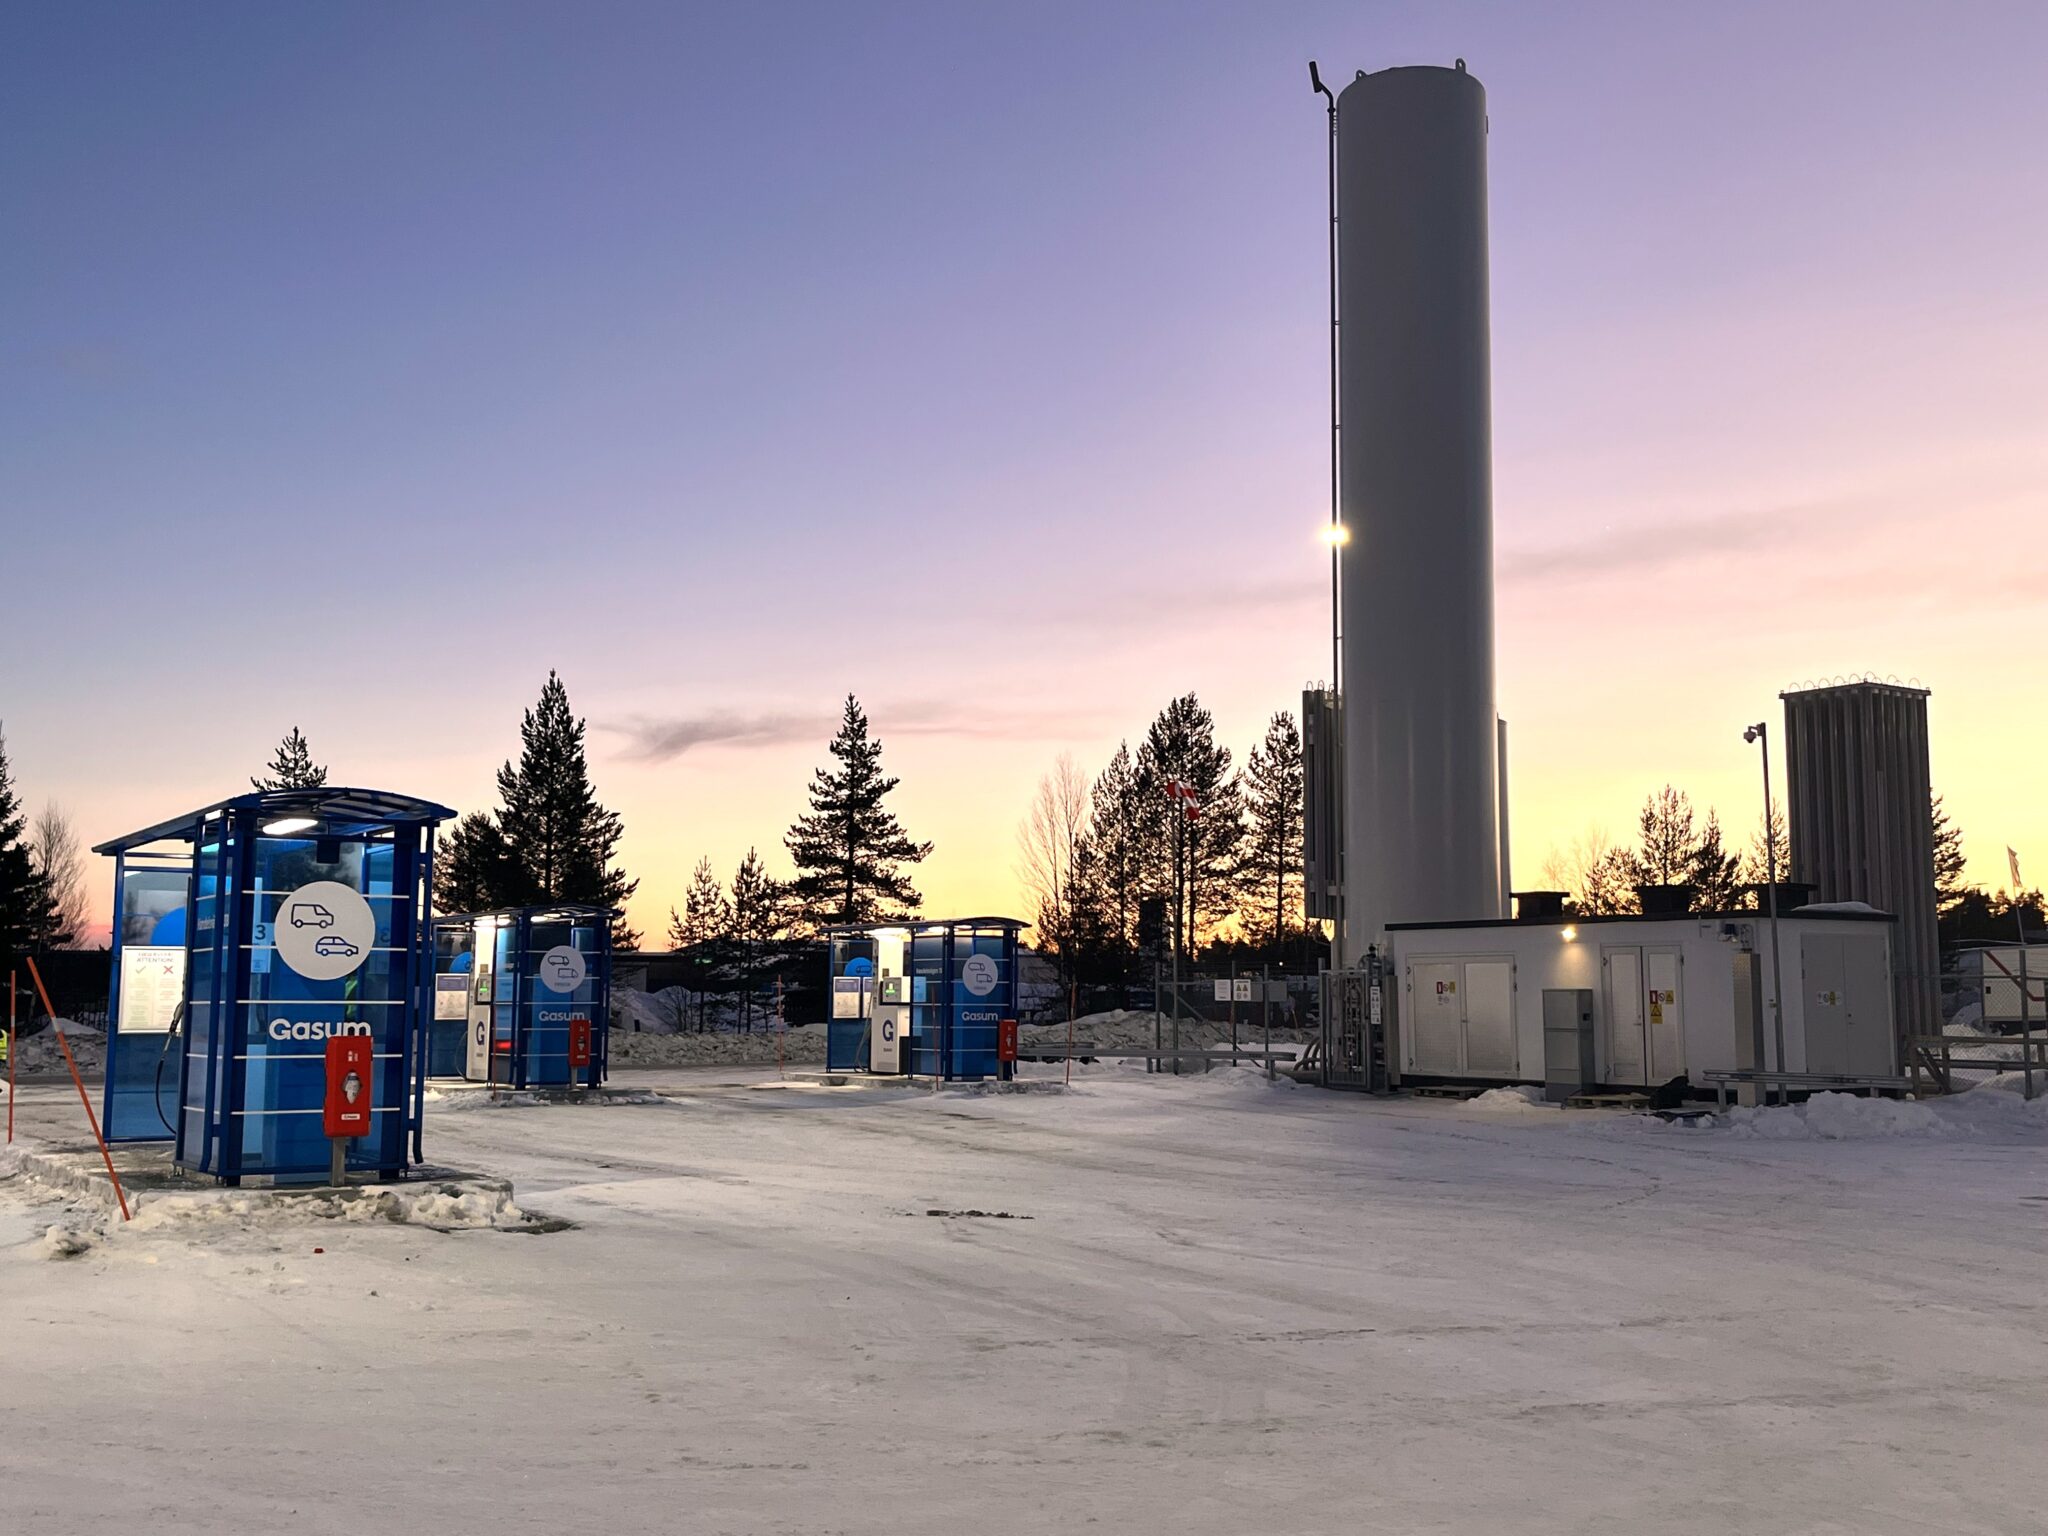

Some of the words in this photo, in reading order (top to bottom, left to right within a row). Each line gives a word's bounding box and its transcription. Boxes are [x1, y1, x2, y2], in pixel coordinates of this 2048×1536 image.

[254, 924, 266, 941] 3
[539, 1011, 585, 1022] Gasum
[962, 1011, 998, 1021] Gasum
[268, 1018, 371, 1041] Gasum
[476, 1021, 486, 1045] G
[882, 1019, 894, 1042] G
